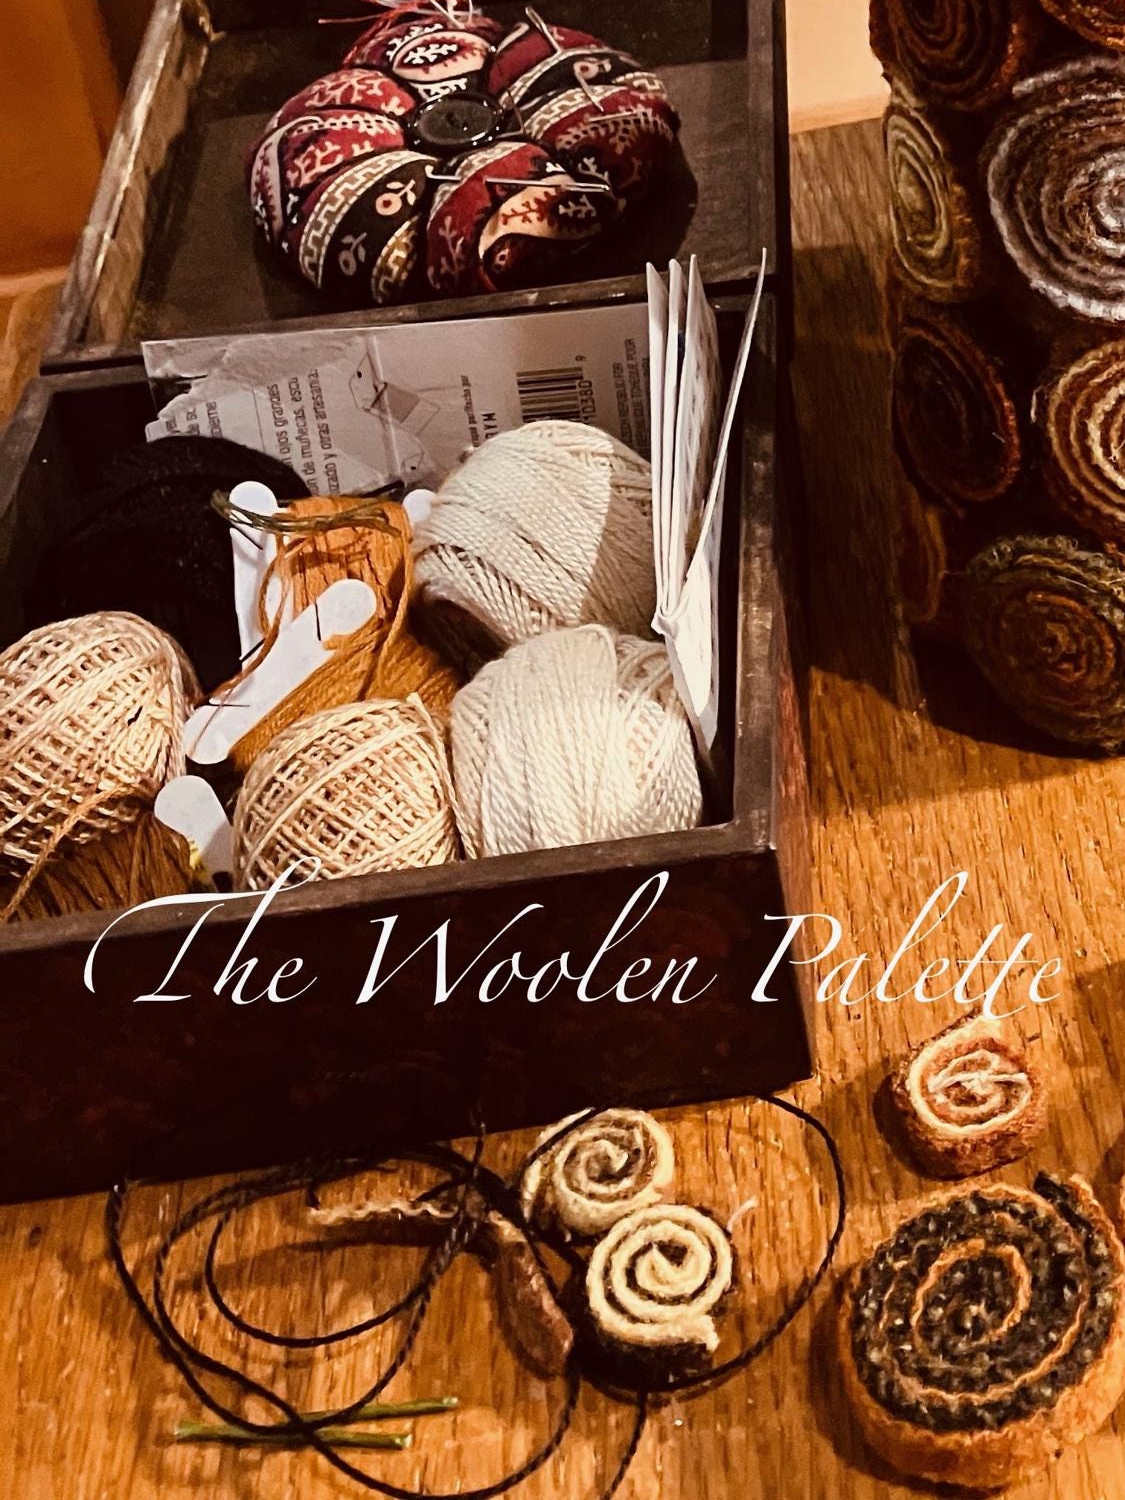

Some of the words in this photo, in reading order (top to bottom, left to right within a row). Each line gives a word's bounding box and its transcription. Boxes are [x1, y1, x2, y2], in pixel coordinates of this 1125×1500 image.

[266, 383, 289, 428] grandes
[276, 429, 291, 455] ojos
[302, 460, 316, 476] de
